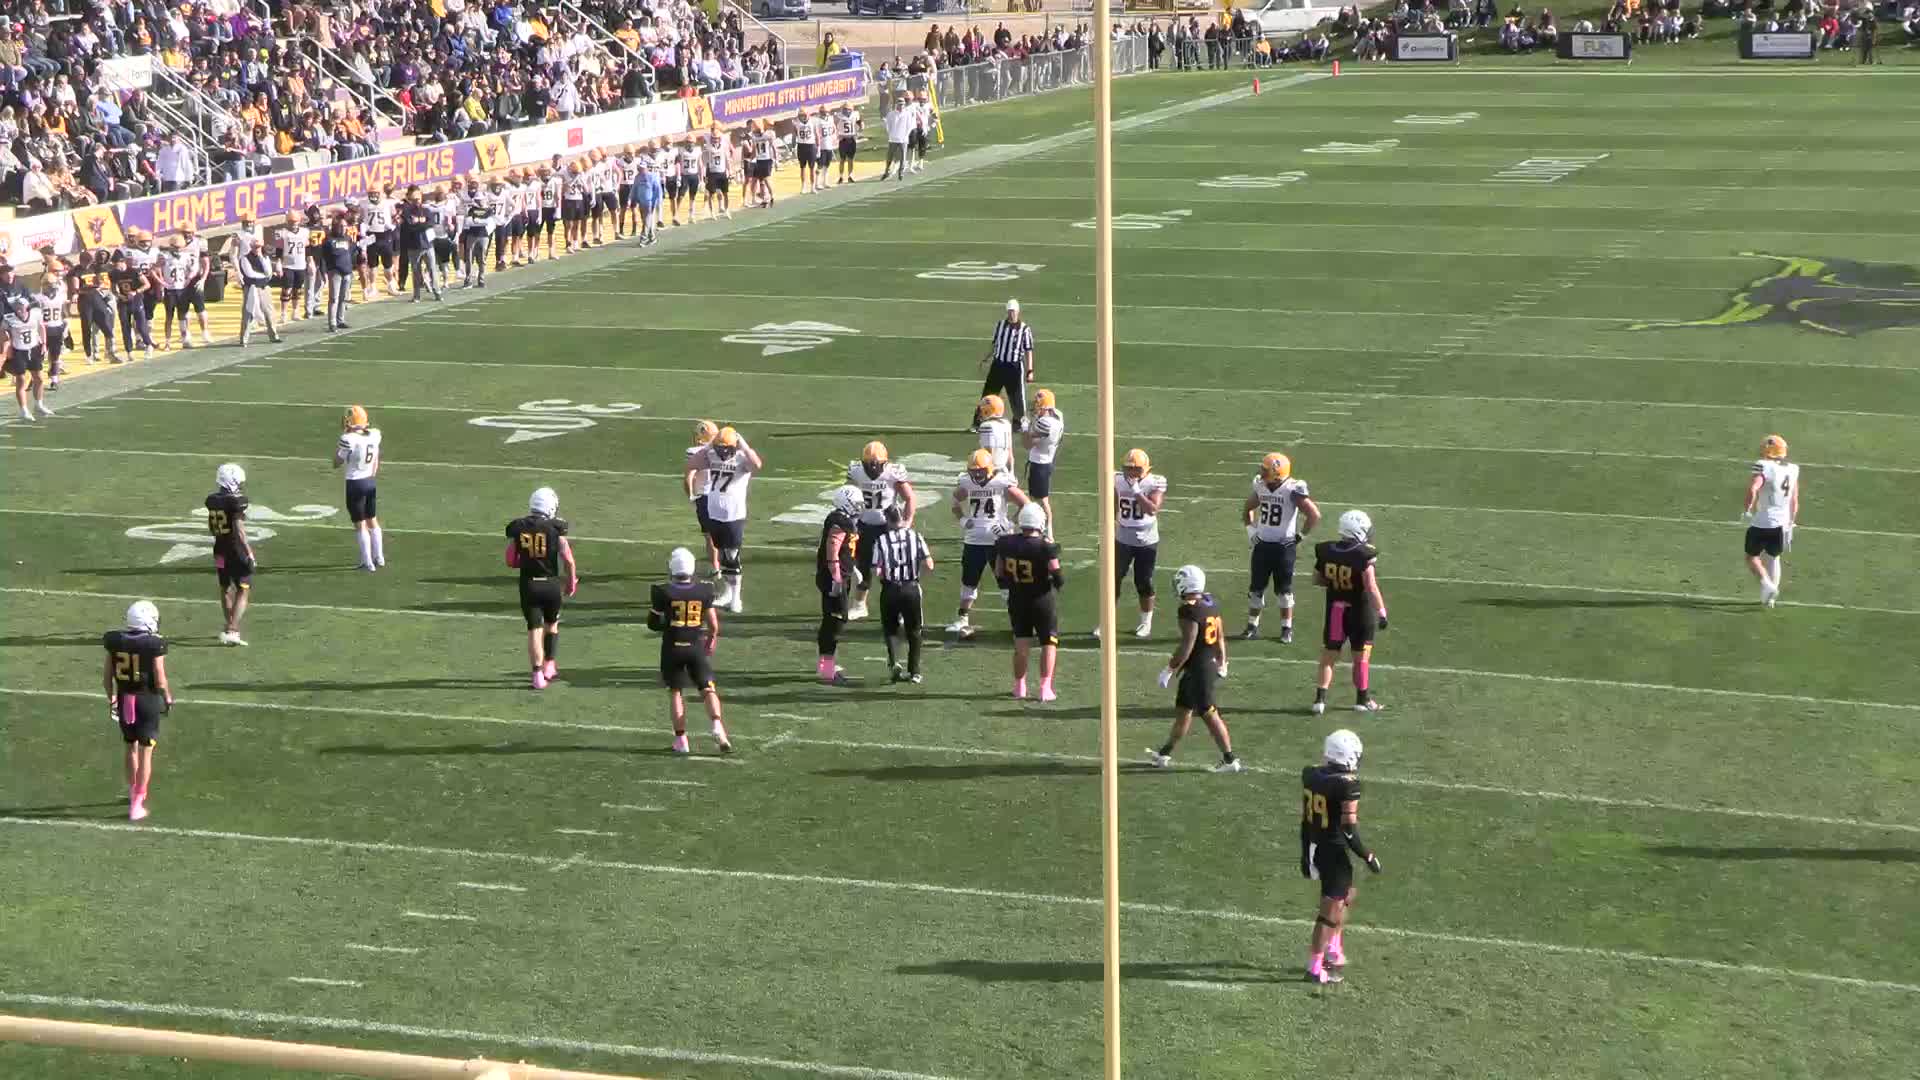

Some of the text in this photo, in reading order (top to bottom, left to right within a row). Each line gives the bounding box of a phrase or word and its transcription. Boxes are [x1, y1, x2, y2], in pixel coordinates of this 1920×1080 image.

[725, 77, 857, 116] MINNESOTA STATE UNIVERSITY
[153, 148, 455, 232] HOME OF THE MAVERICKS
[368, 211, 385, 226] 75
[467, 399, 643, 429] 30
[365, 444, 374, 464] 6
[710, 470, 734, 492] 77
[1780, 475, 1791, 498] 4
[970, 498, 995, 518] 74
[1260, 502, 1282, 526] 68
[520, 532, 547, 559] 90
[1005, 557, 1034, 584] 93
[1325, 562, 1352, 591] 98
[114, 651, 140, 682] 21
